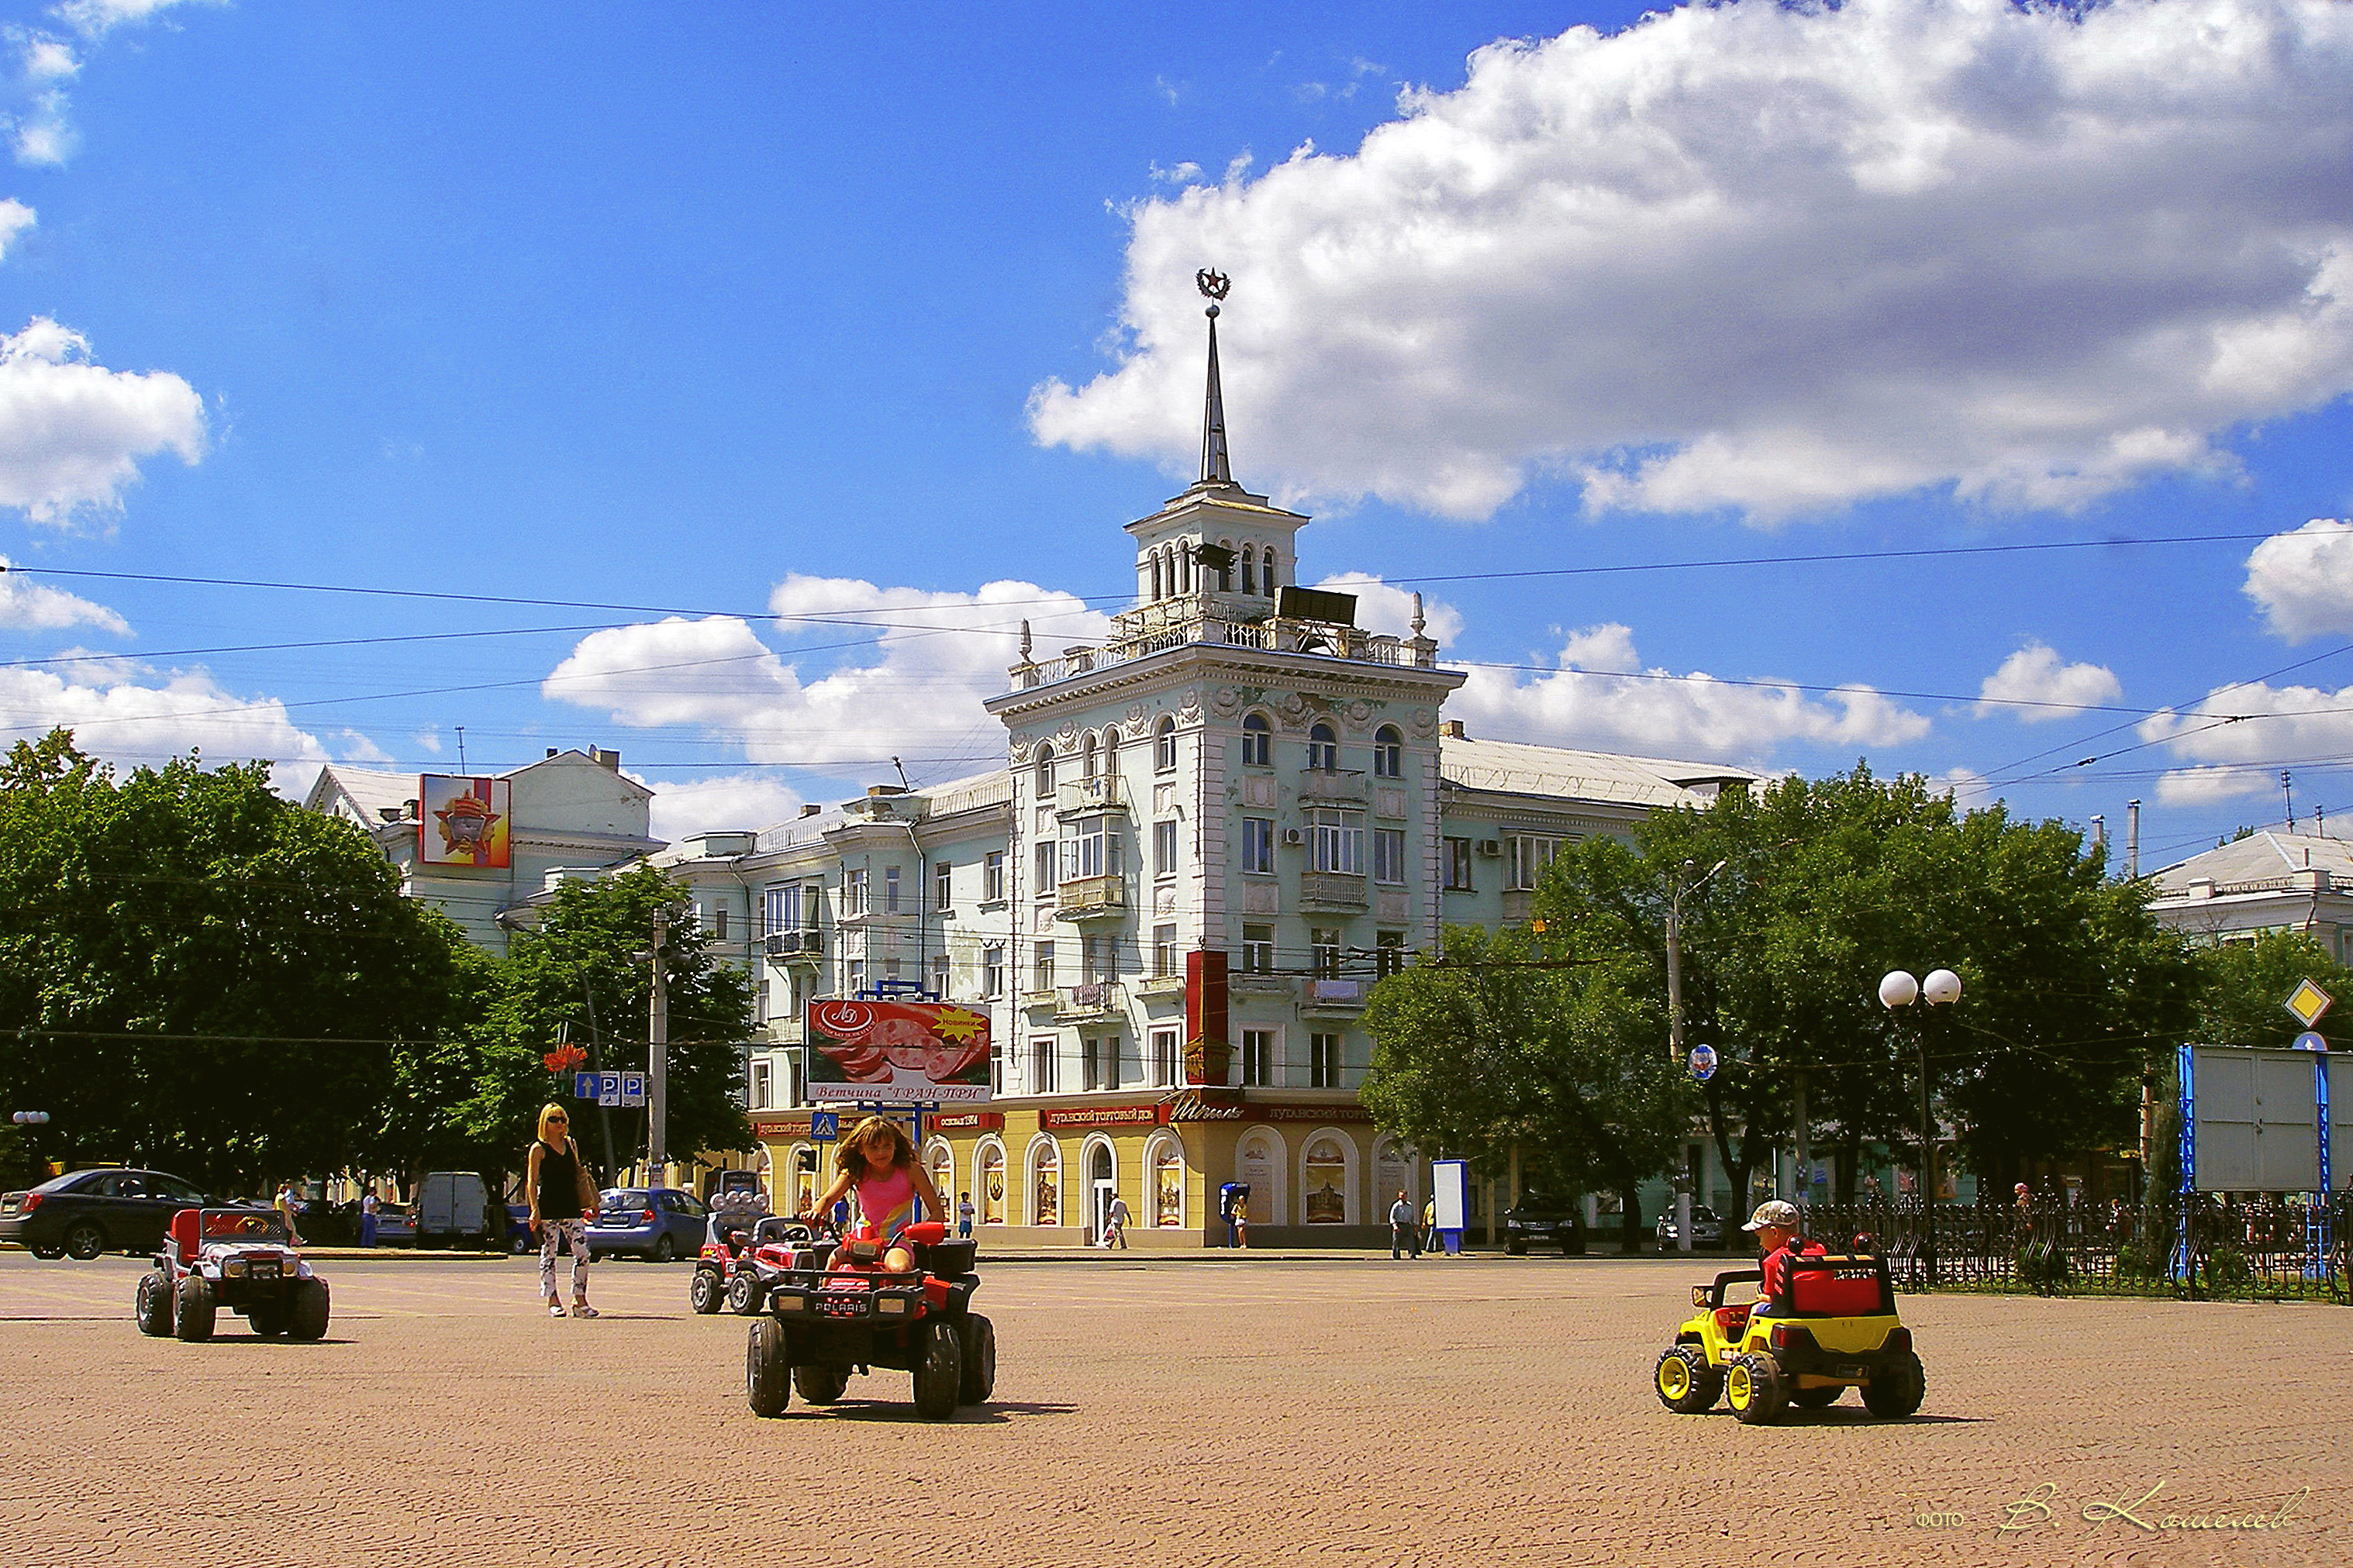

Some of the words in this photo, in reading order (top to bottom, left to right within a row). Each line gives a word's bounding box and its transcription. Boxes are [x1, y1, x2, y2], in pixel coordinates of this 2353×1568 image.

[942, 1018, 977, 1027] Новинки
[816, 1086, 882, 1099] Ветчина
[1050, 1109, 1094, 1125] ЛУГАНСКИЙ
[1095, 1108, 1137, 1122] ТОРГОВЫЙ
[1269, 1108, 1336, 1120] ЛУГАНСКИЙ
[816, 1302, 867, 1312] POLARIS
